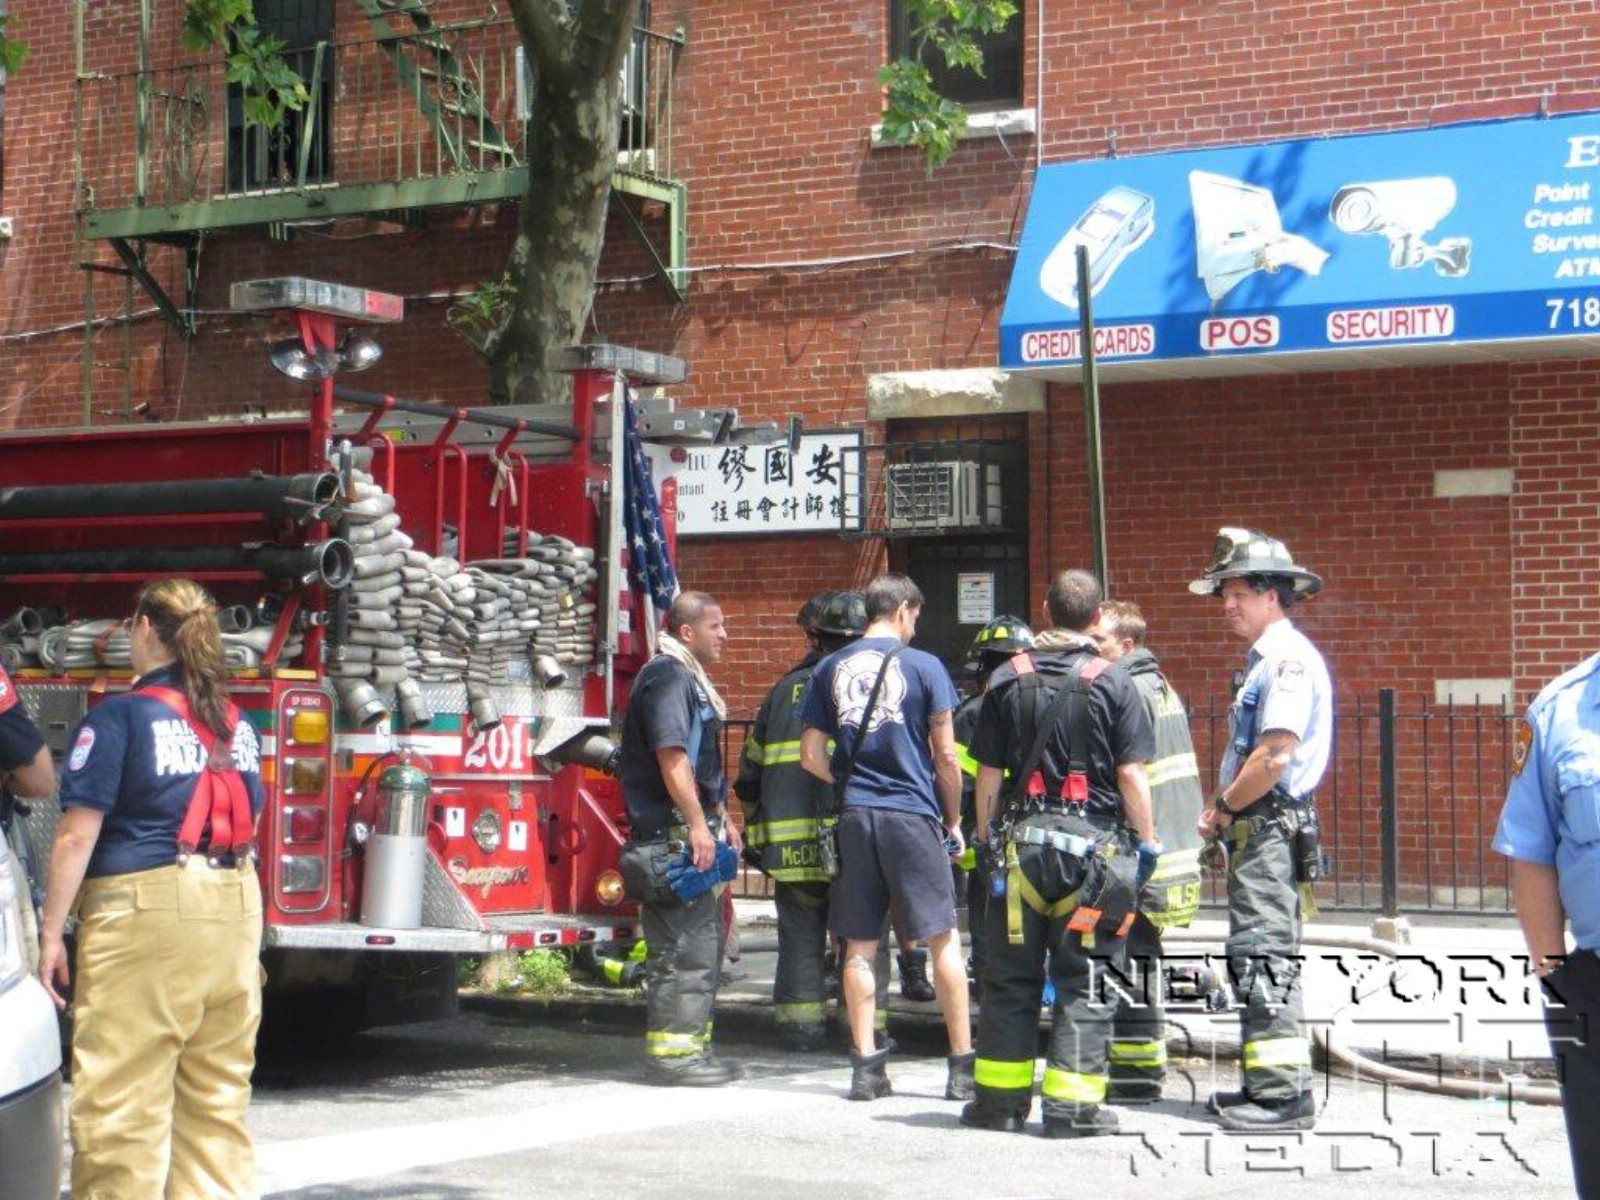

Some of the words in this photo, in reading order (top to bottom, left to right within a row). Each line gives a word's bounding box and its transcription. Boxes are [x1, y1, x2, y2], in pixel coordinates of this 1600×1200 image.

[1563, 134, 1600, 169] E
[1534, 181, 1591, 203] Point
[1524, 207, 1594, 229] Credit
[1331, 307, 1449, 340] SECURITY
[1545, 297, 1600, 329] 718
[1094, 326, 1151, 355] CARDS
[1207, 318, 1273, 347] POS
[465, 719, 524, 769] 201
